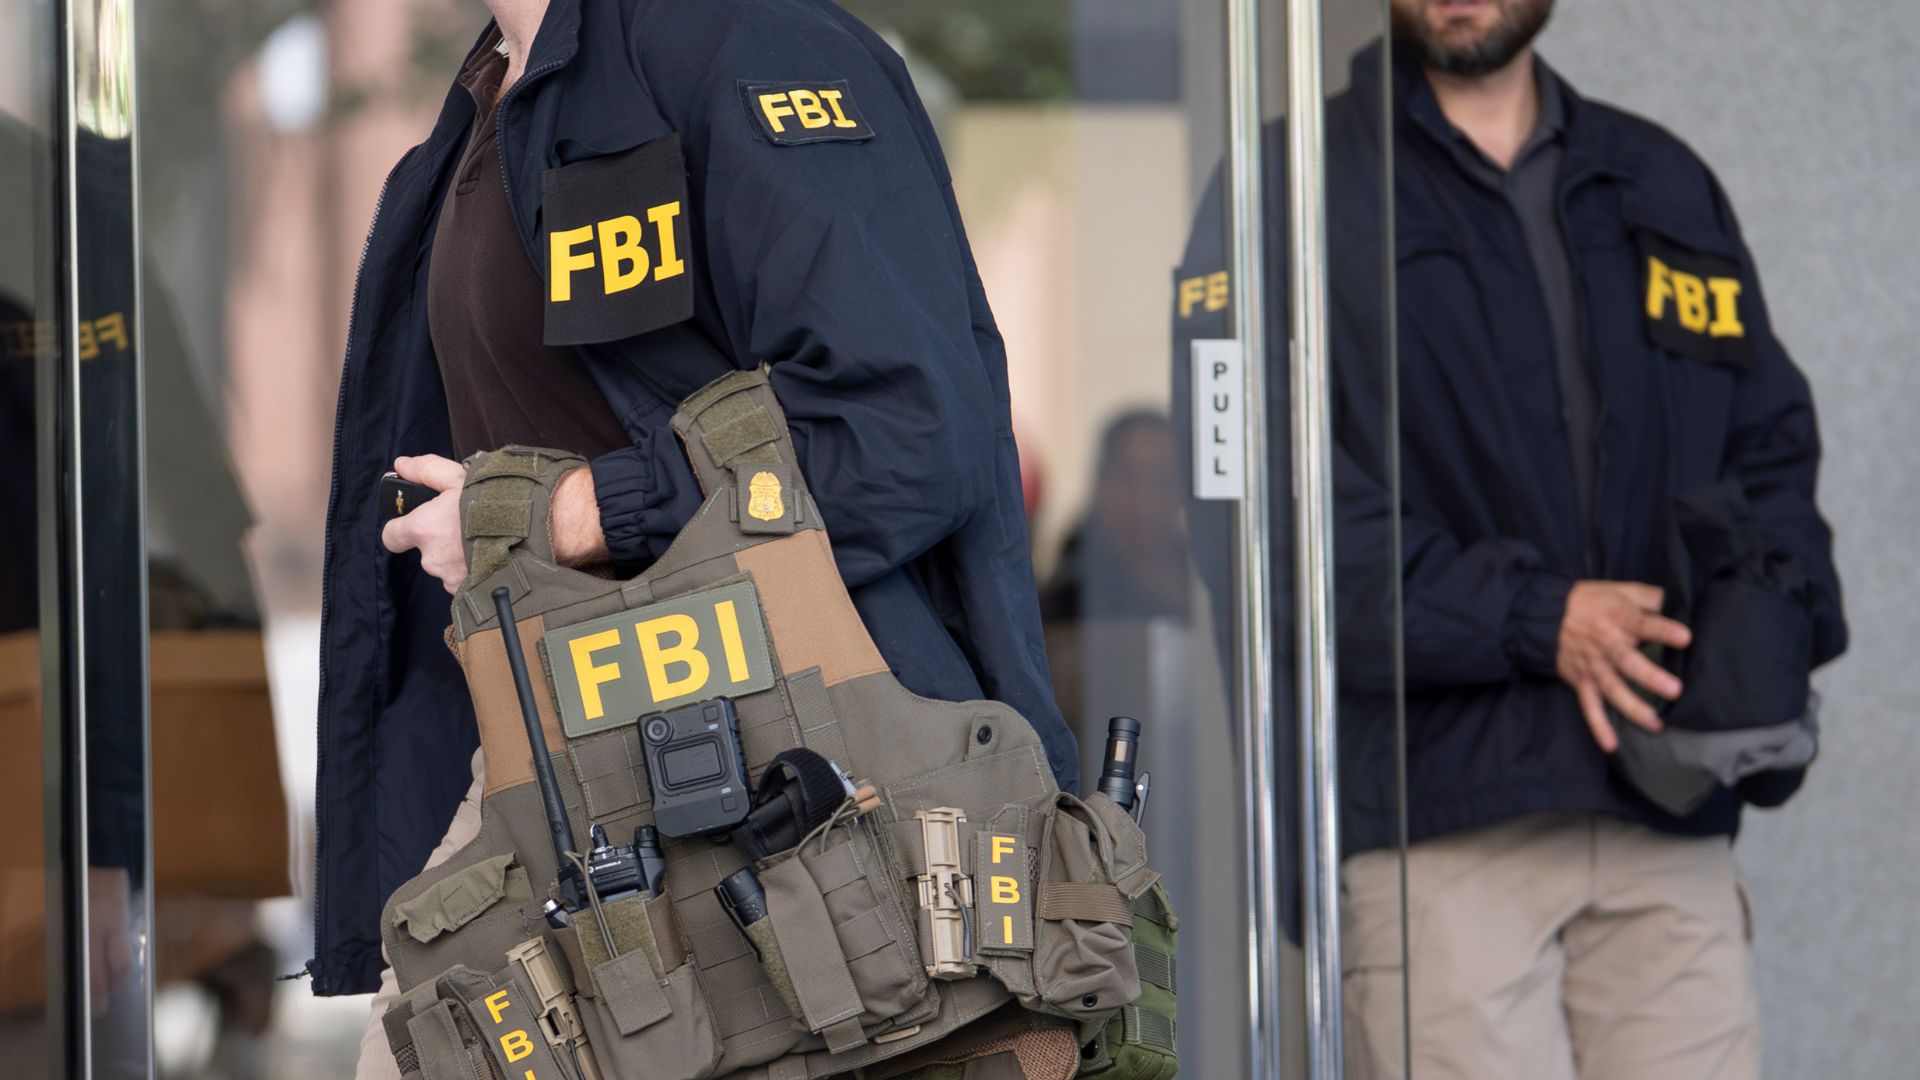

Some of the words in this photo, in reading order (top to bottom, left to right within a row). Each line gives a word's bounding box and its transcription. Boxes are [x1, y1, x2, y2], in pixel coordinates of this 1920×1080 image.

[758, 89, 857, 133] FBI
[550, 200, 685, 302] FBI
[1645, 255, 1745, 337] FBI
[1213, 361, 1229, 475] PULL
[568, 600, 750, 720] FBI
[991, 836, 1021, 944] FBI
